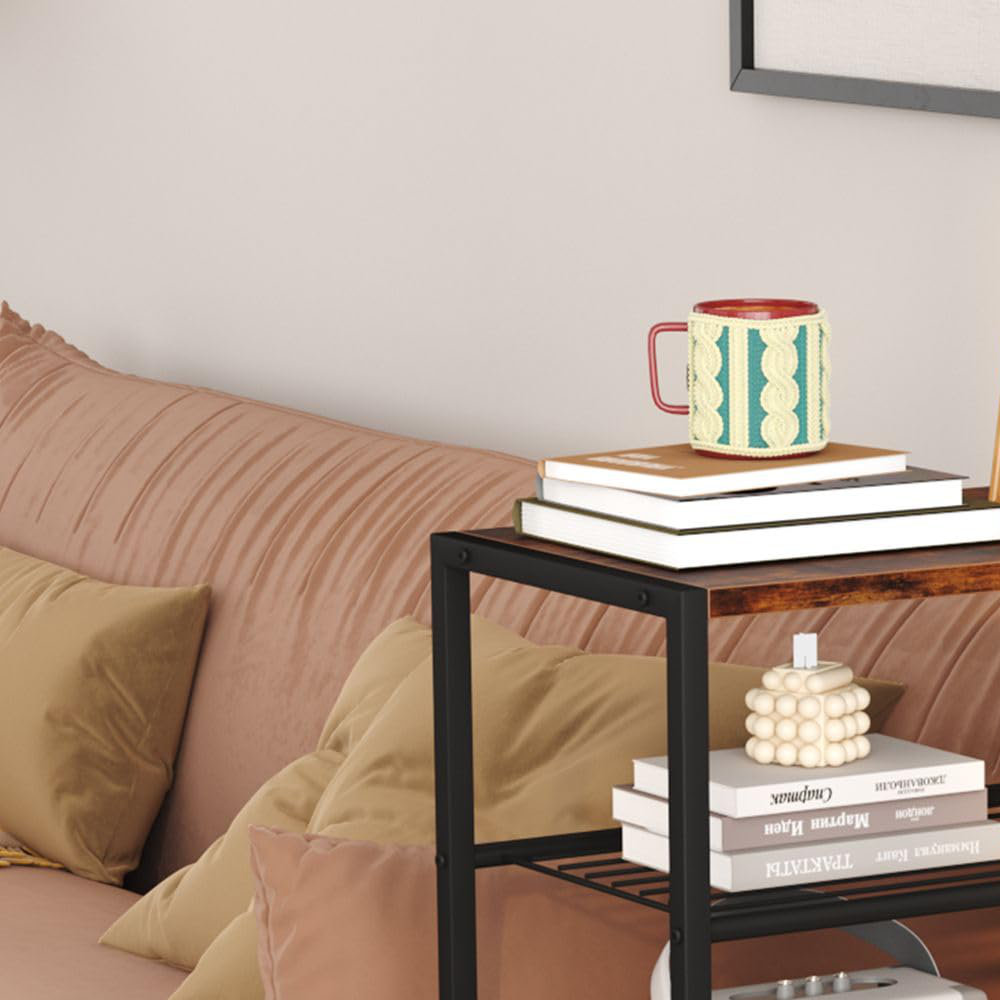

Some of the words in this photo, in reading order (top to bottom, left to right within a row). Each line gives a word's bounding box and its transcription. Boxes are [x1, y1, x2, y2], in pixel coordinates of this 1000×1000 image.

[770, 785, 832, 805] Спартак
[764, 819, 804, 836] Иден
[810, 811, 870, 830] Мартин
[875, 848, 909, 863] Кант
[766, 853, 854, 878] ТРАКТАТЫ
